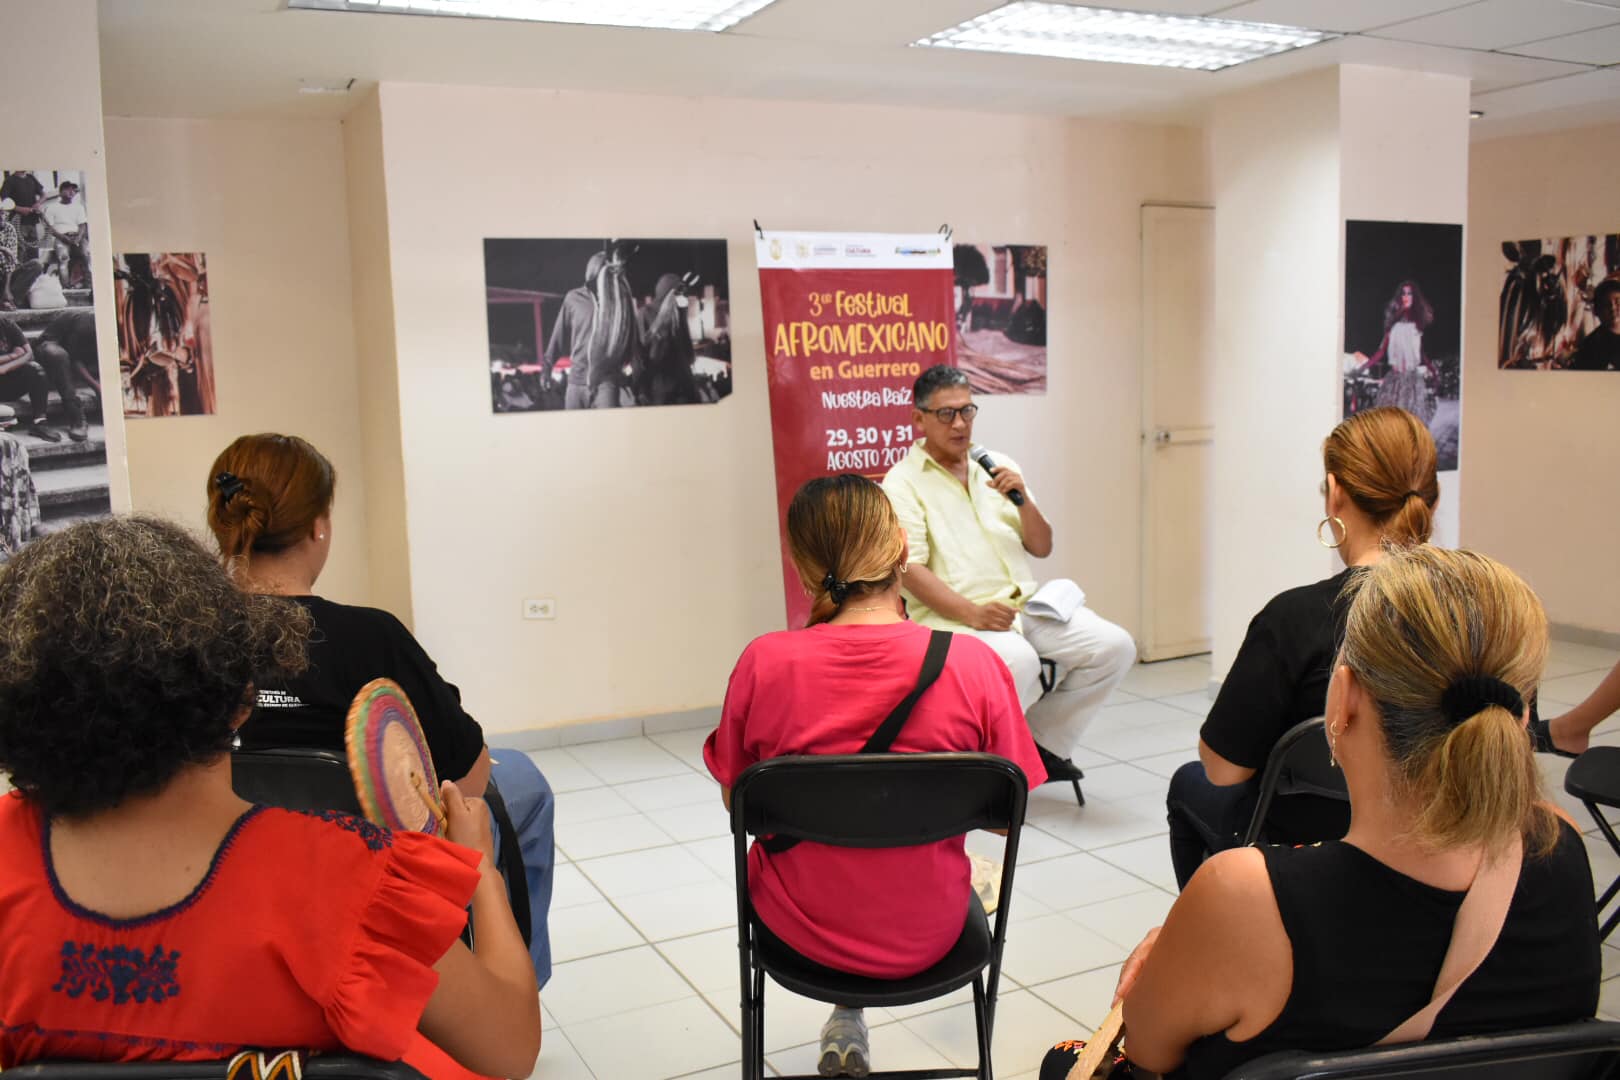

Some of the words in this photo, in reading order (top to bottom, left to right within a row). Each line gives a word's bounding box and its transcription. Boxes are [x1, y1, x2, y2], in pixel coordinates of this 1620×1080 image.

[836, 290, 913, 318] Festival
[773, 320, 949, 357] AFROMEXICANO
[810, 365, 834, 380] en
[838, 360, 921, 379] Guerrero
[821, 388, 881, 410] Nuestra
[825, 428, 854, 449] 29,
[856, 426, 879, 445] 30
[881, 429, 893, 448] y
[895, 424, 913, 442] 31
[827, 448, 880, 471] AGOSTO
[881, 446, 912, 467] 202
